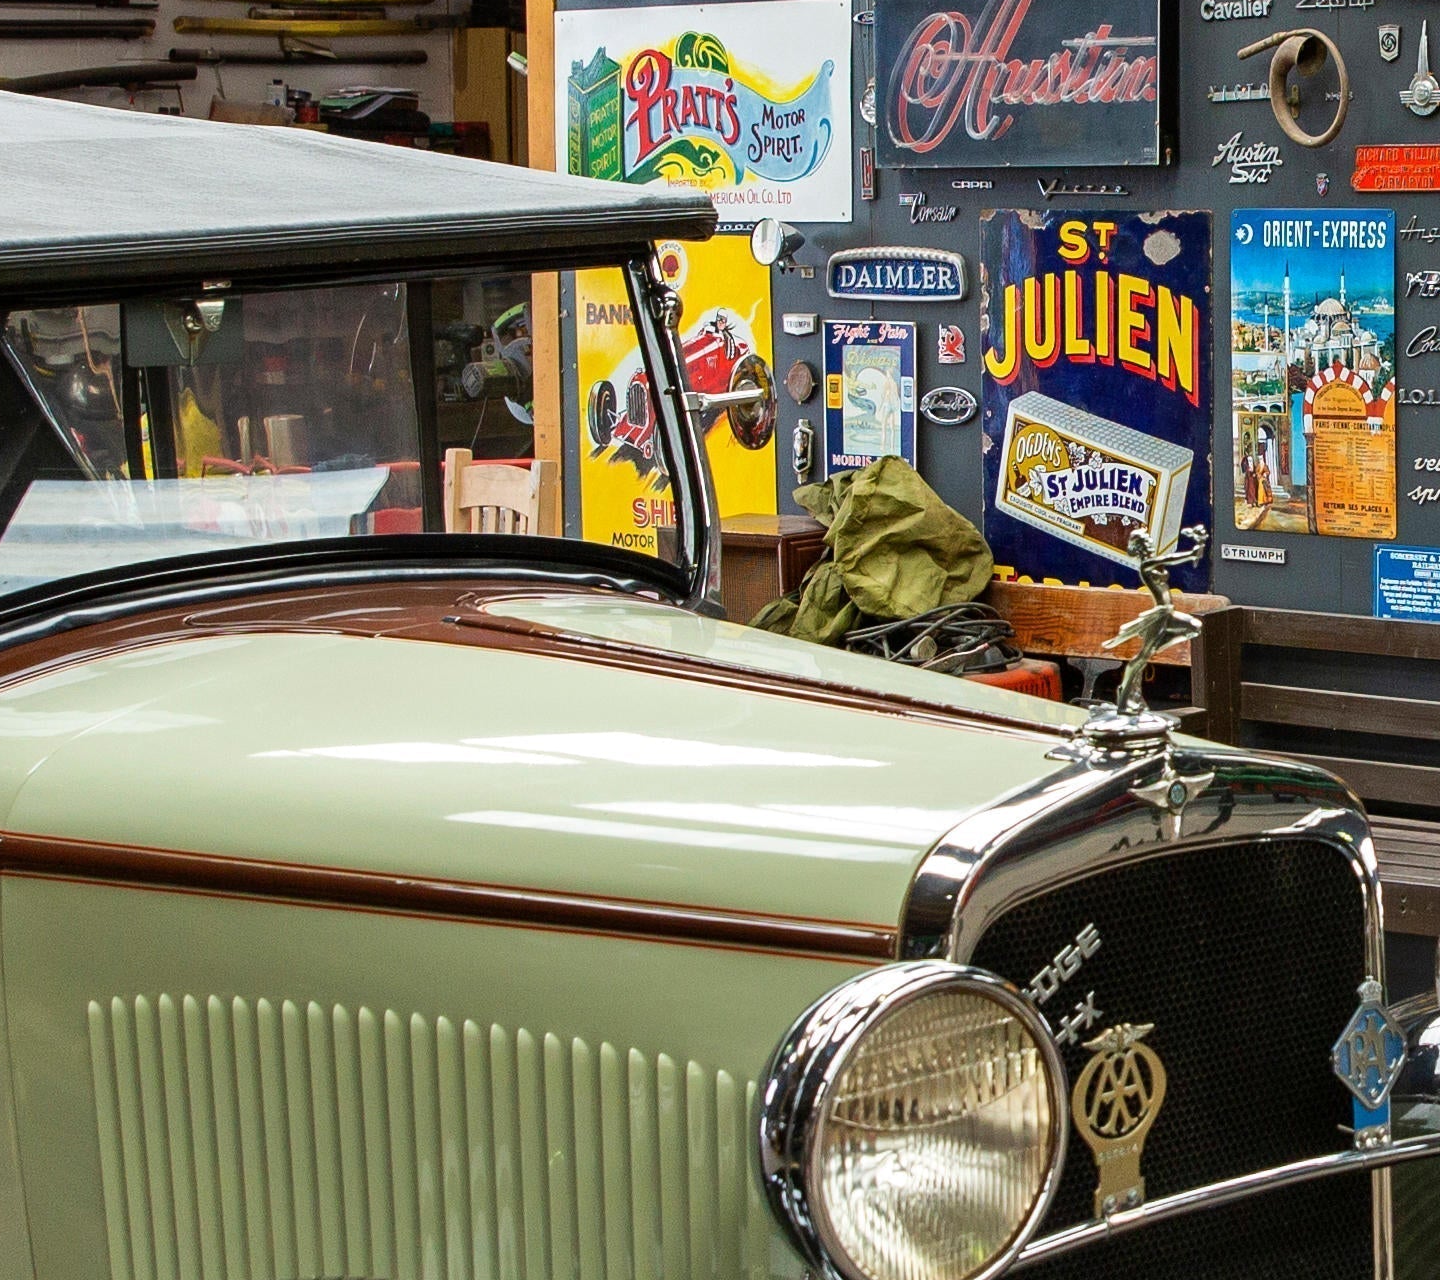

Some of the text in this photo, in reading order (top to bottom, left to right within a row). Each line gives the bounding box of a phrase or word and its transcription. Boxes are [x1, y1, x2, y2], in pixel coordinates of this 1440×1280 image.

[762, 102, 805, 129] MOTOR
[1212, 131, 1283, 167] Austin
[1229, 165, 1272, 184] Six
[1263, 219, 1386, 249] ORIENT-EXPRESS
[839, 263, 958, 291] DAIMLER
[985, 271, 1199, 408] JULIEN
[1072, 467, 1142, 497] JULIEN
[1070, 493, 1144, 514] EMPIRE BLEND
[1231, 547, 1284, 562] TRIUMPH
